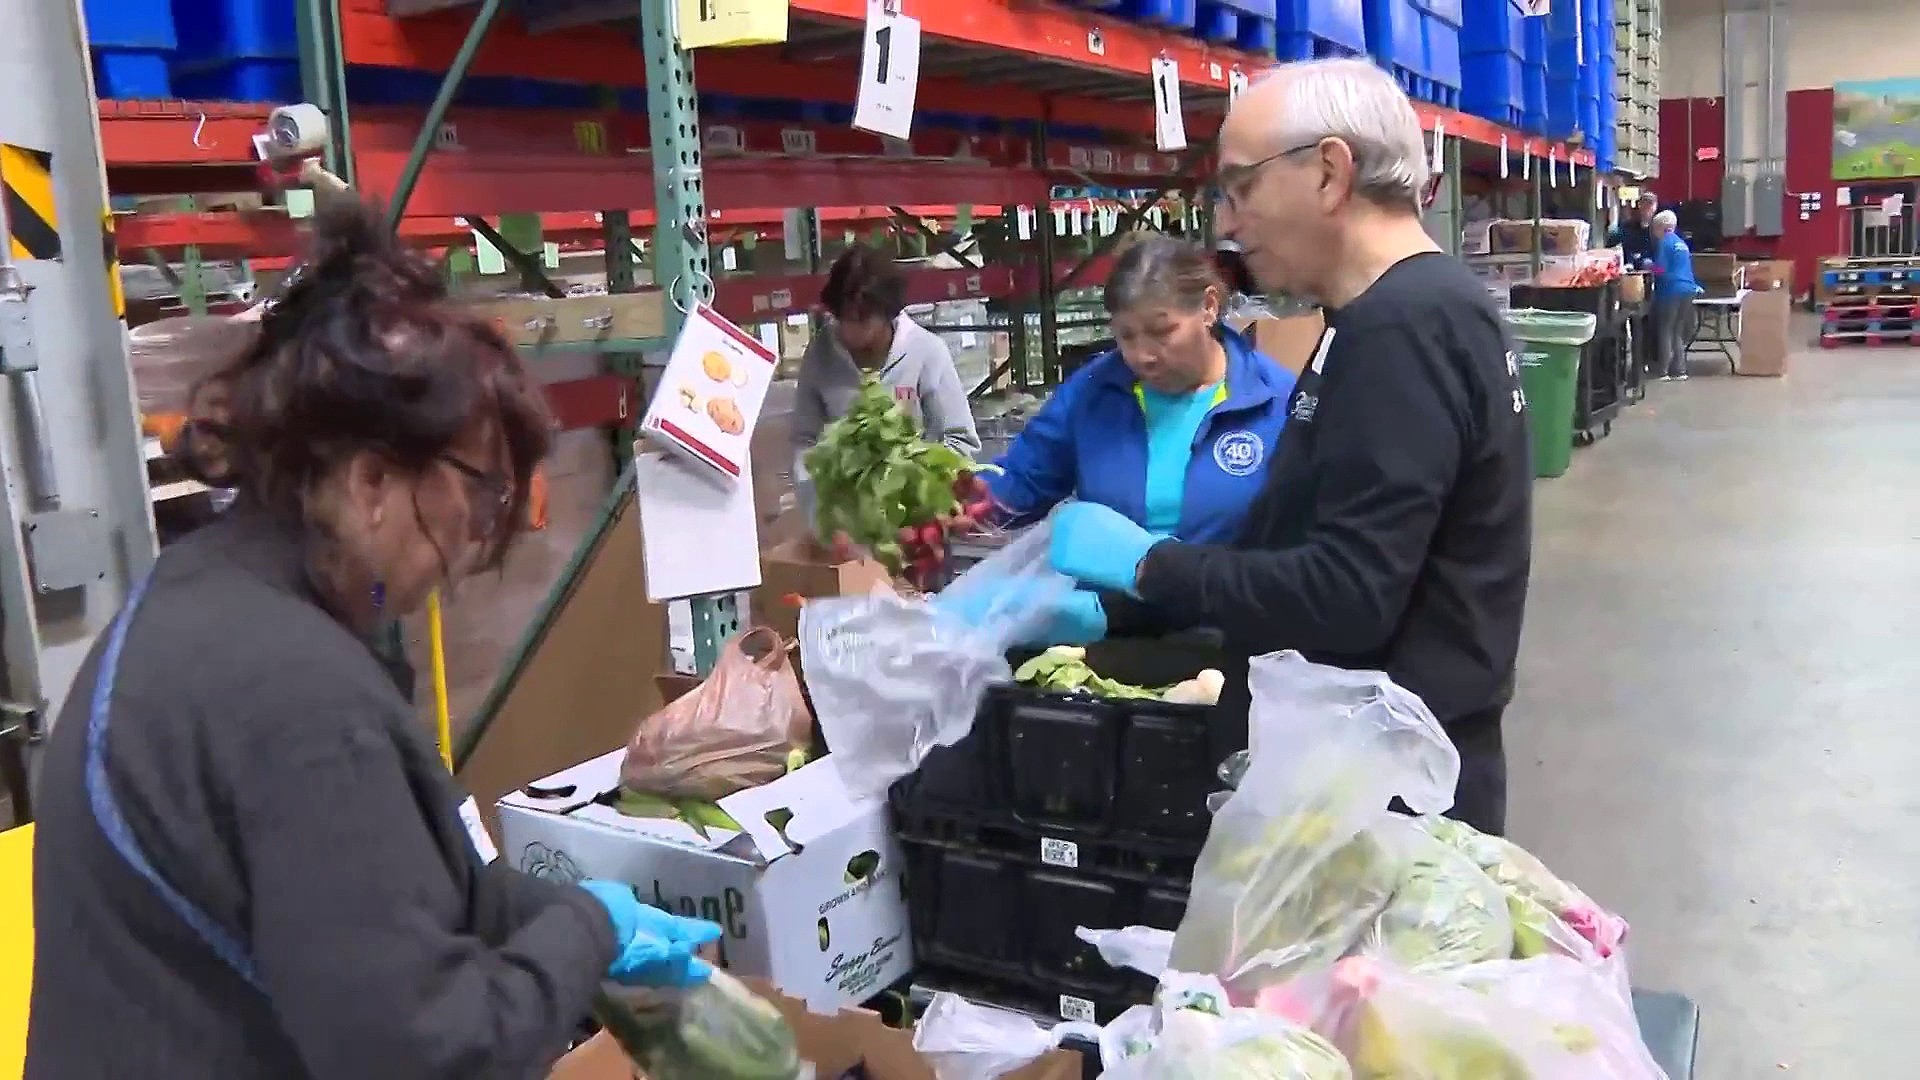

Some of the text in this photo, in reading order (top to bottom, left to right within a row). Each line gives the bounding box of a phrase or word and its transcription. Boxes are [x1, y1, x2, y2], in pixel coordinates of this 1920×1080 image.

[875, 26, 891, 84] 1
[1159, 74, 1169, 114] 1
[1225, 442, 1252, 459] 40
